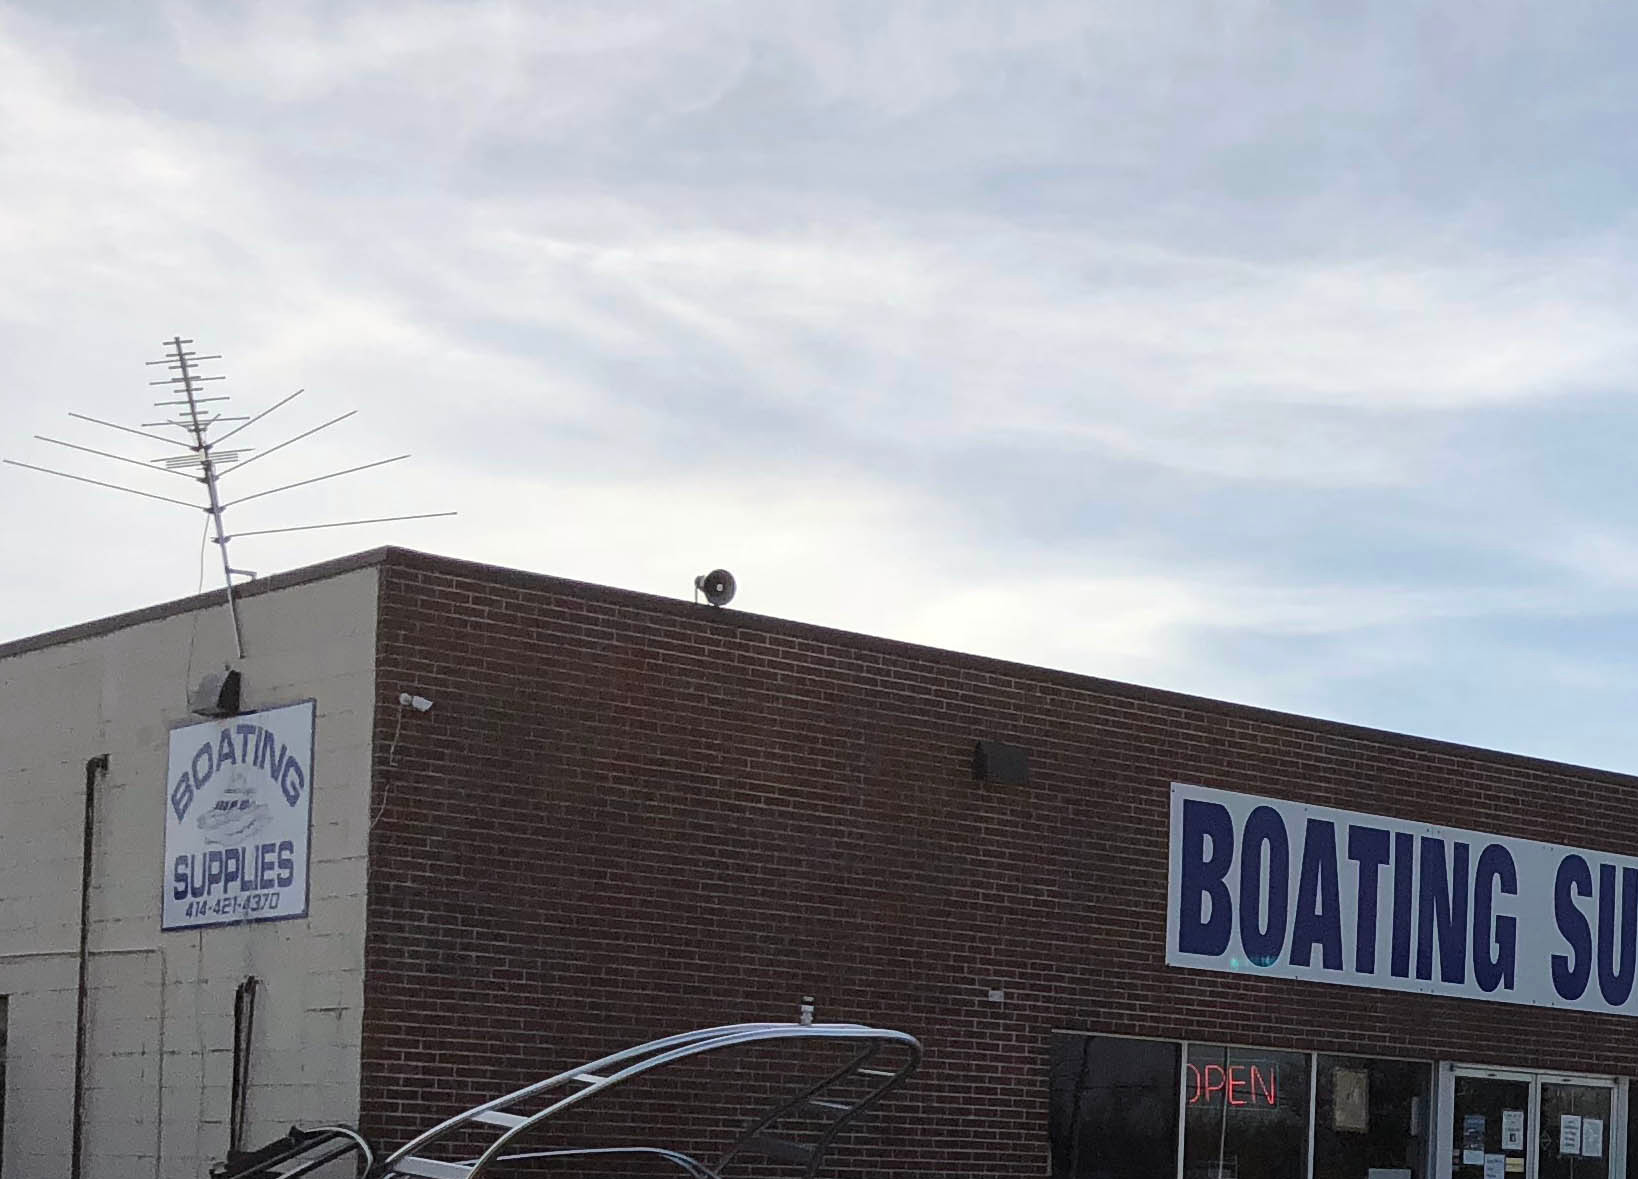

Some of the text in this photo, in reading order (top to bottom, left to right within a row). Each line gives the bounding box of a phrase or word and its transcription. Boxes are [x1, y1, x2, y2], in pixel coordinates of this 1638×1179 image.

[171, 723, 305, 825] BOATING
[173, 839, 295, 901] SUPPLIES
[185, 891, 280, 919] 414-421-4370
[1178, 799, 1518, 993] BOATING
